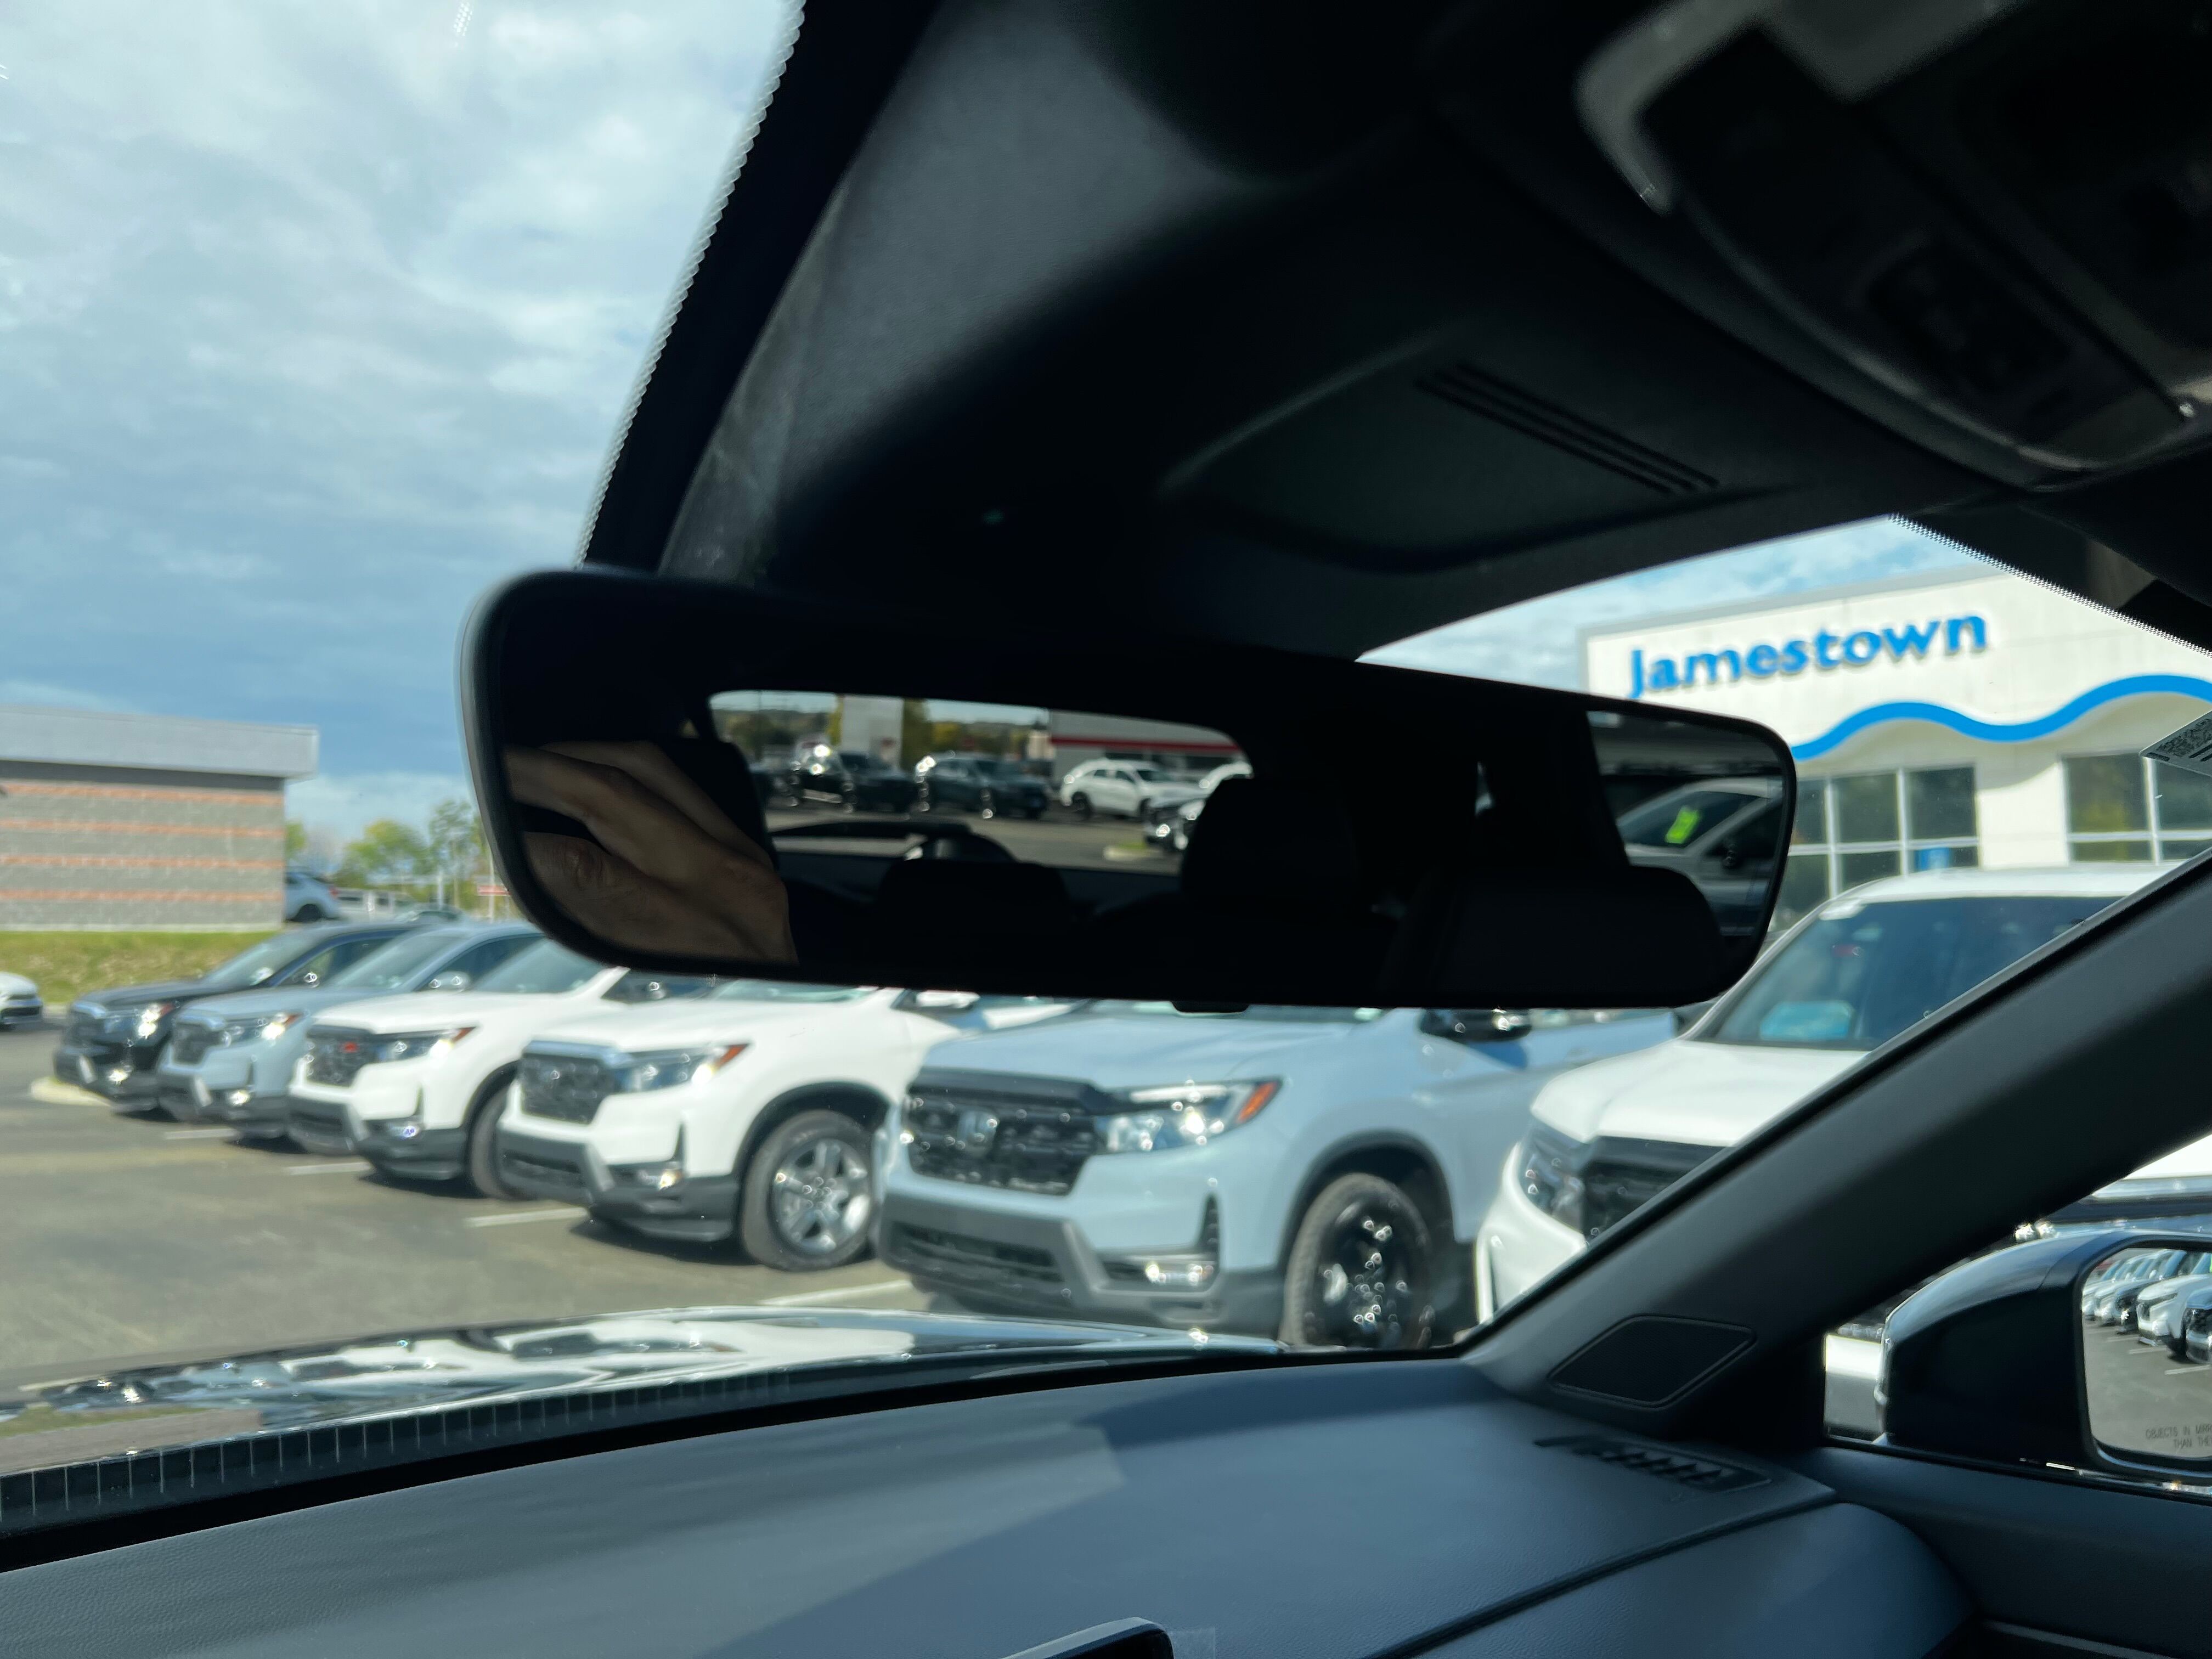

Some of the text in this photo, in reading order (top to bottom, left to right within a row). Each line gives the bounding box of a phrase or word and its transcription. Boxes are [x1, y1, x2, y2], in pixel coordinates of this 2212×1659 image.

[1629, 615, 1988, 700] Jamestown
[2145, 1426, 2179, 1438] OBJECTS
[2173, 1438, 2192, 1449] THAN
